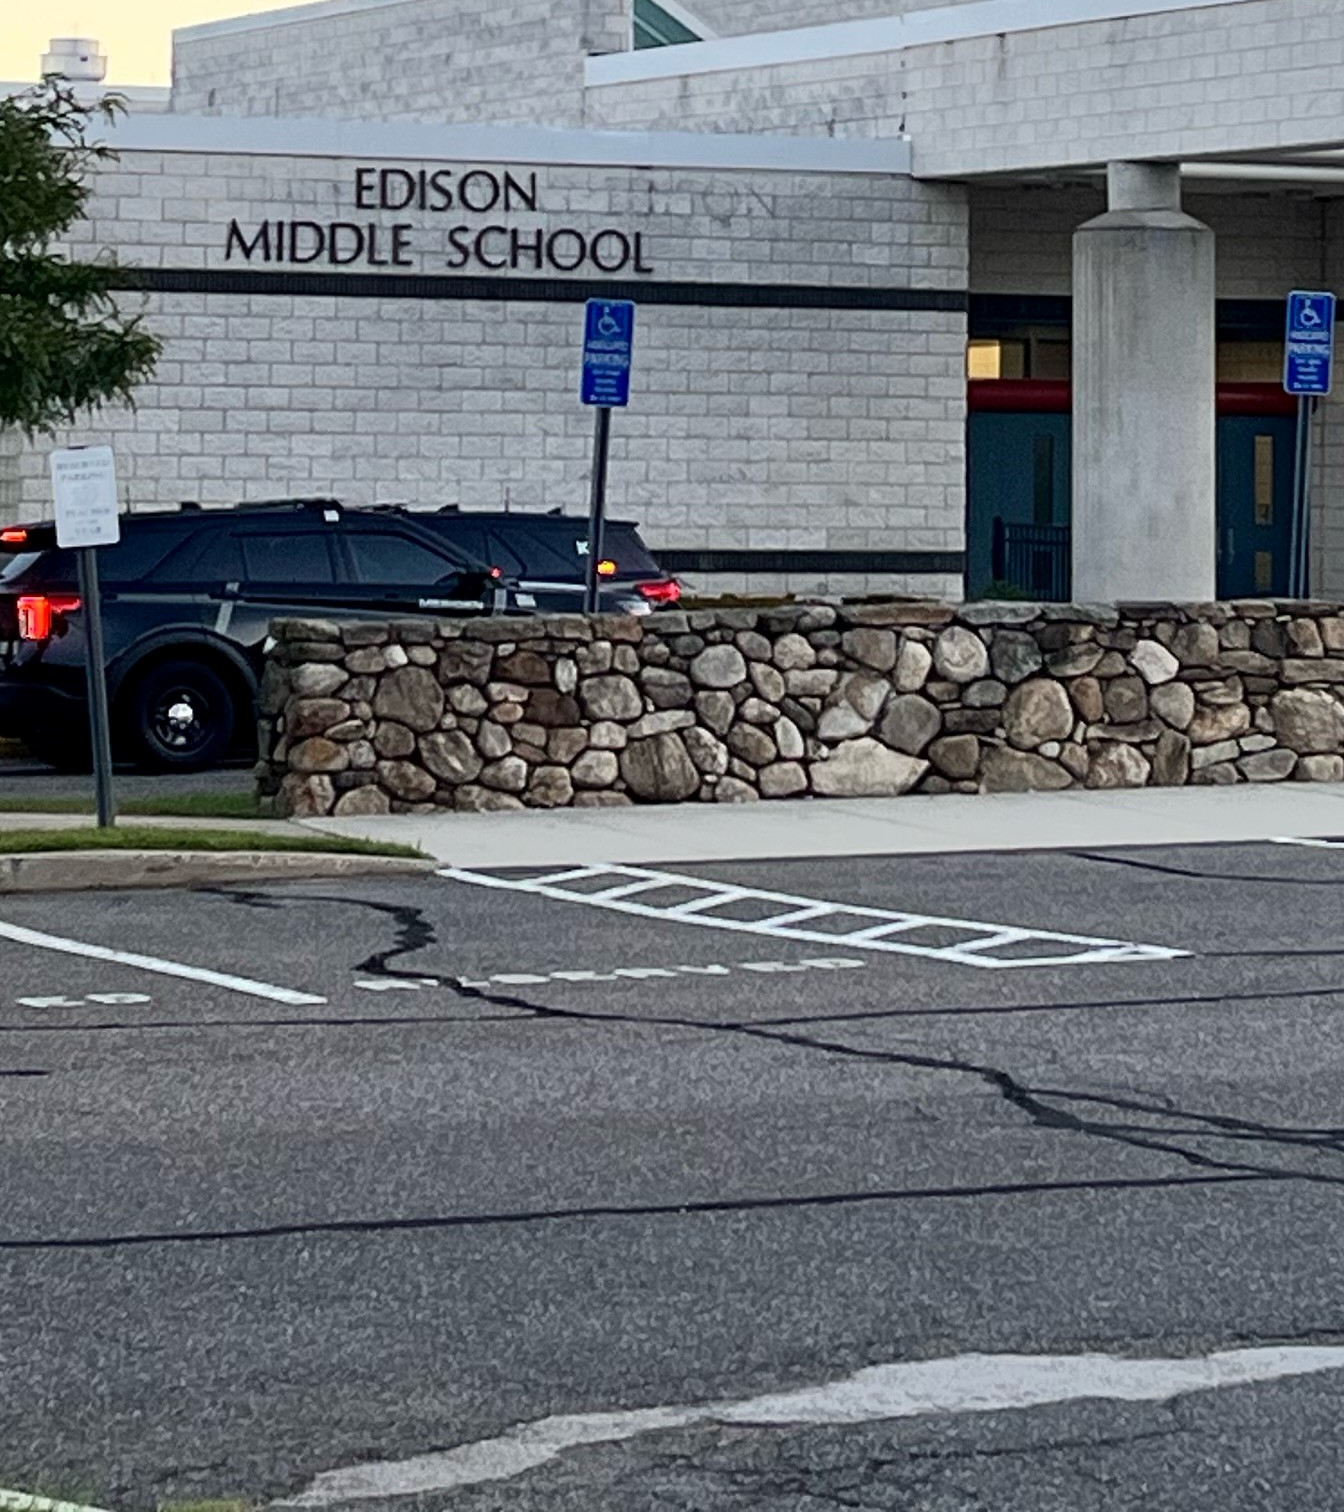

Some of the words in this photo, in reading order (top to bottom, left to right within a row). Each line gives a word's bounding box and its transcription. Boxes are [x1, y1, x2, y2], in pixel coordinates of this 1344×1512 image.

[355, 168, 537, 212] EDISON
[225, 219, 413, 267] MIDDLE
[447, 225, 653, 273] SCHOOL
